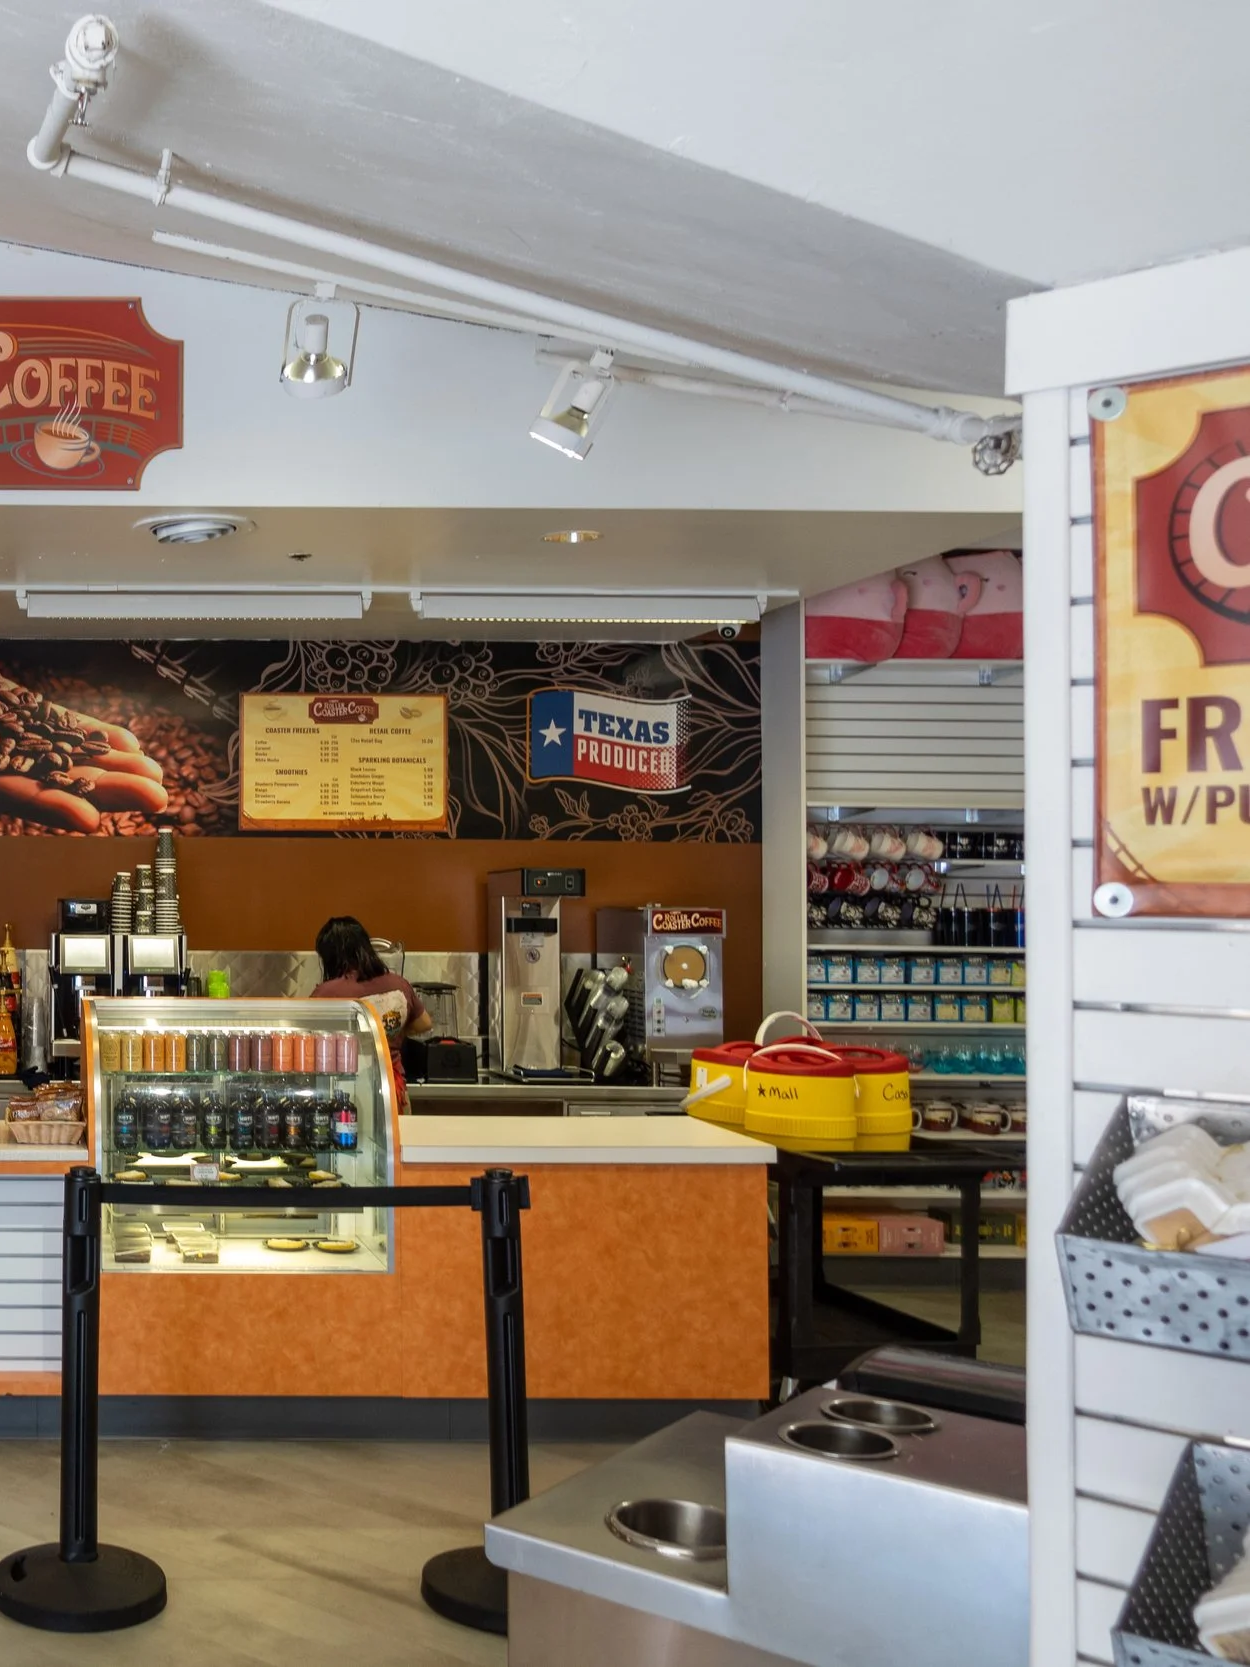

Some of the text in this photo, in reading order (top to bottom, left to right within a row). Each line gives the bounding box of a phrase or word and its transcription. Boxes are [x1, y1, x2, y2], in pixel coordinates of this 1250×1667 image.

[578, 709, 670, 744] TEXAS
[578, 739, 670, 774] PRODUCED
[652, 913, 722, 931] COASTER COFFEE
[768, 1086, 799, 1100] Mall
